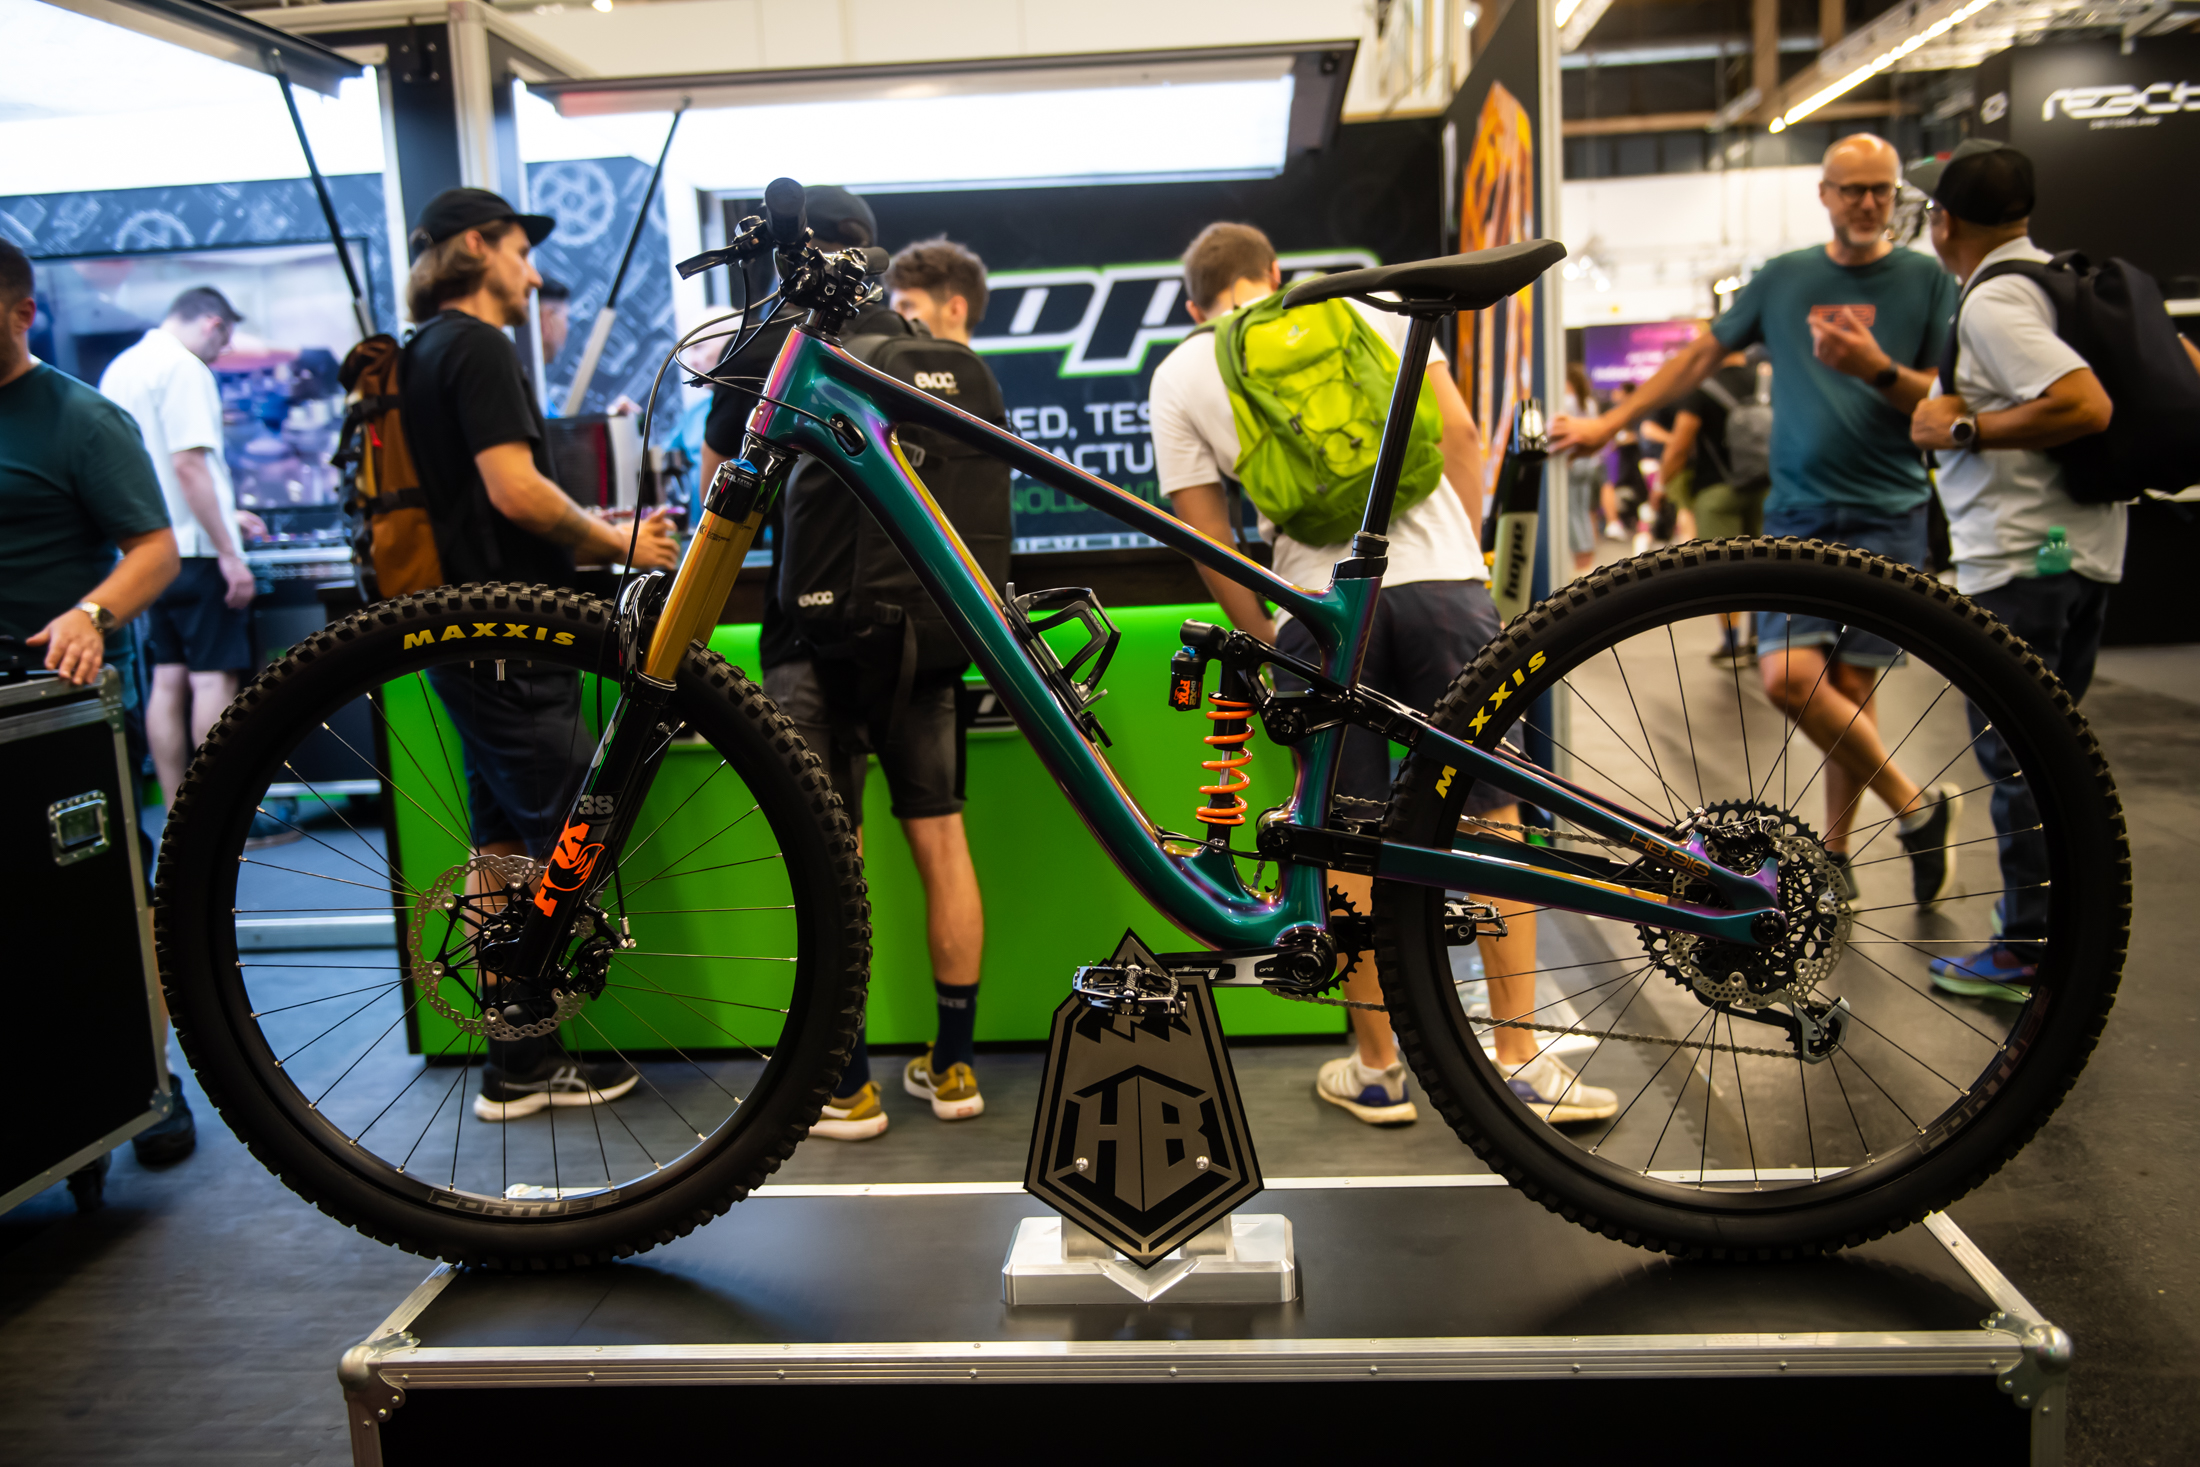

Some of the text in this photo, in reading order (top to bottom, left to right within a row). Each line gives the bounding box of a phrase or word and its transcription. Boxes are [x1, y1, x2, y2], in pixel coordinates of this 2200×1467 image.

[1005, 406, 1078, 440] ED,
[403, 622, 576, 650] MAXXIS
[1173, 679, 1191, 705] FOX
[1435, 650, 1547, 799] MXXIS
[534, 813, 605, 917] FOX
[1915, 1010, 2043, 1155] FORTUS
[1070, 1075, 1214, 1214] HB
[427, 1189, 594, 1218] FORTUS
